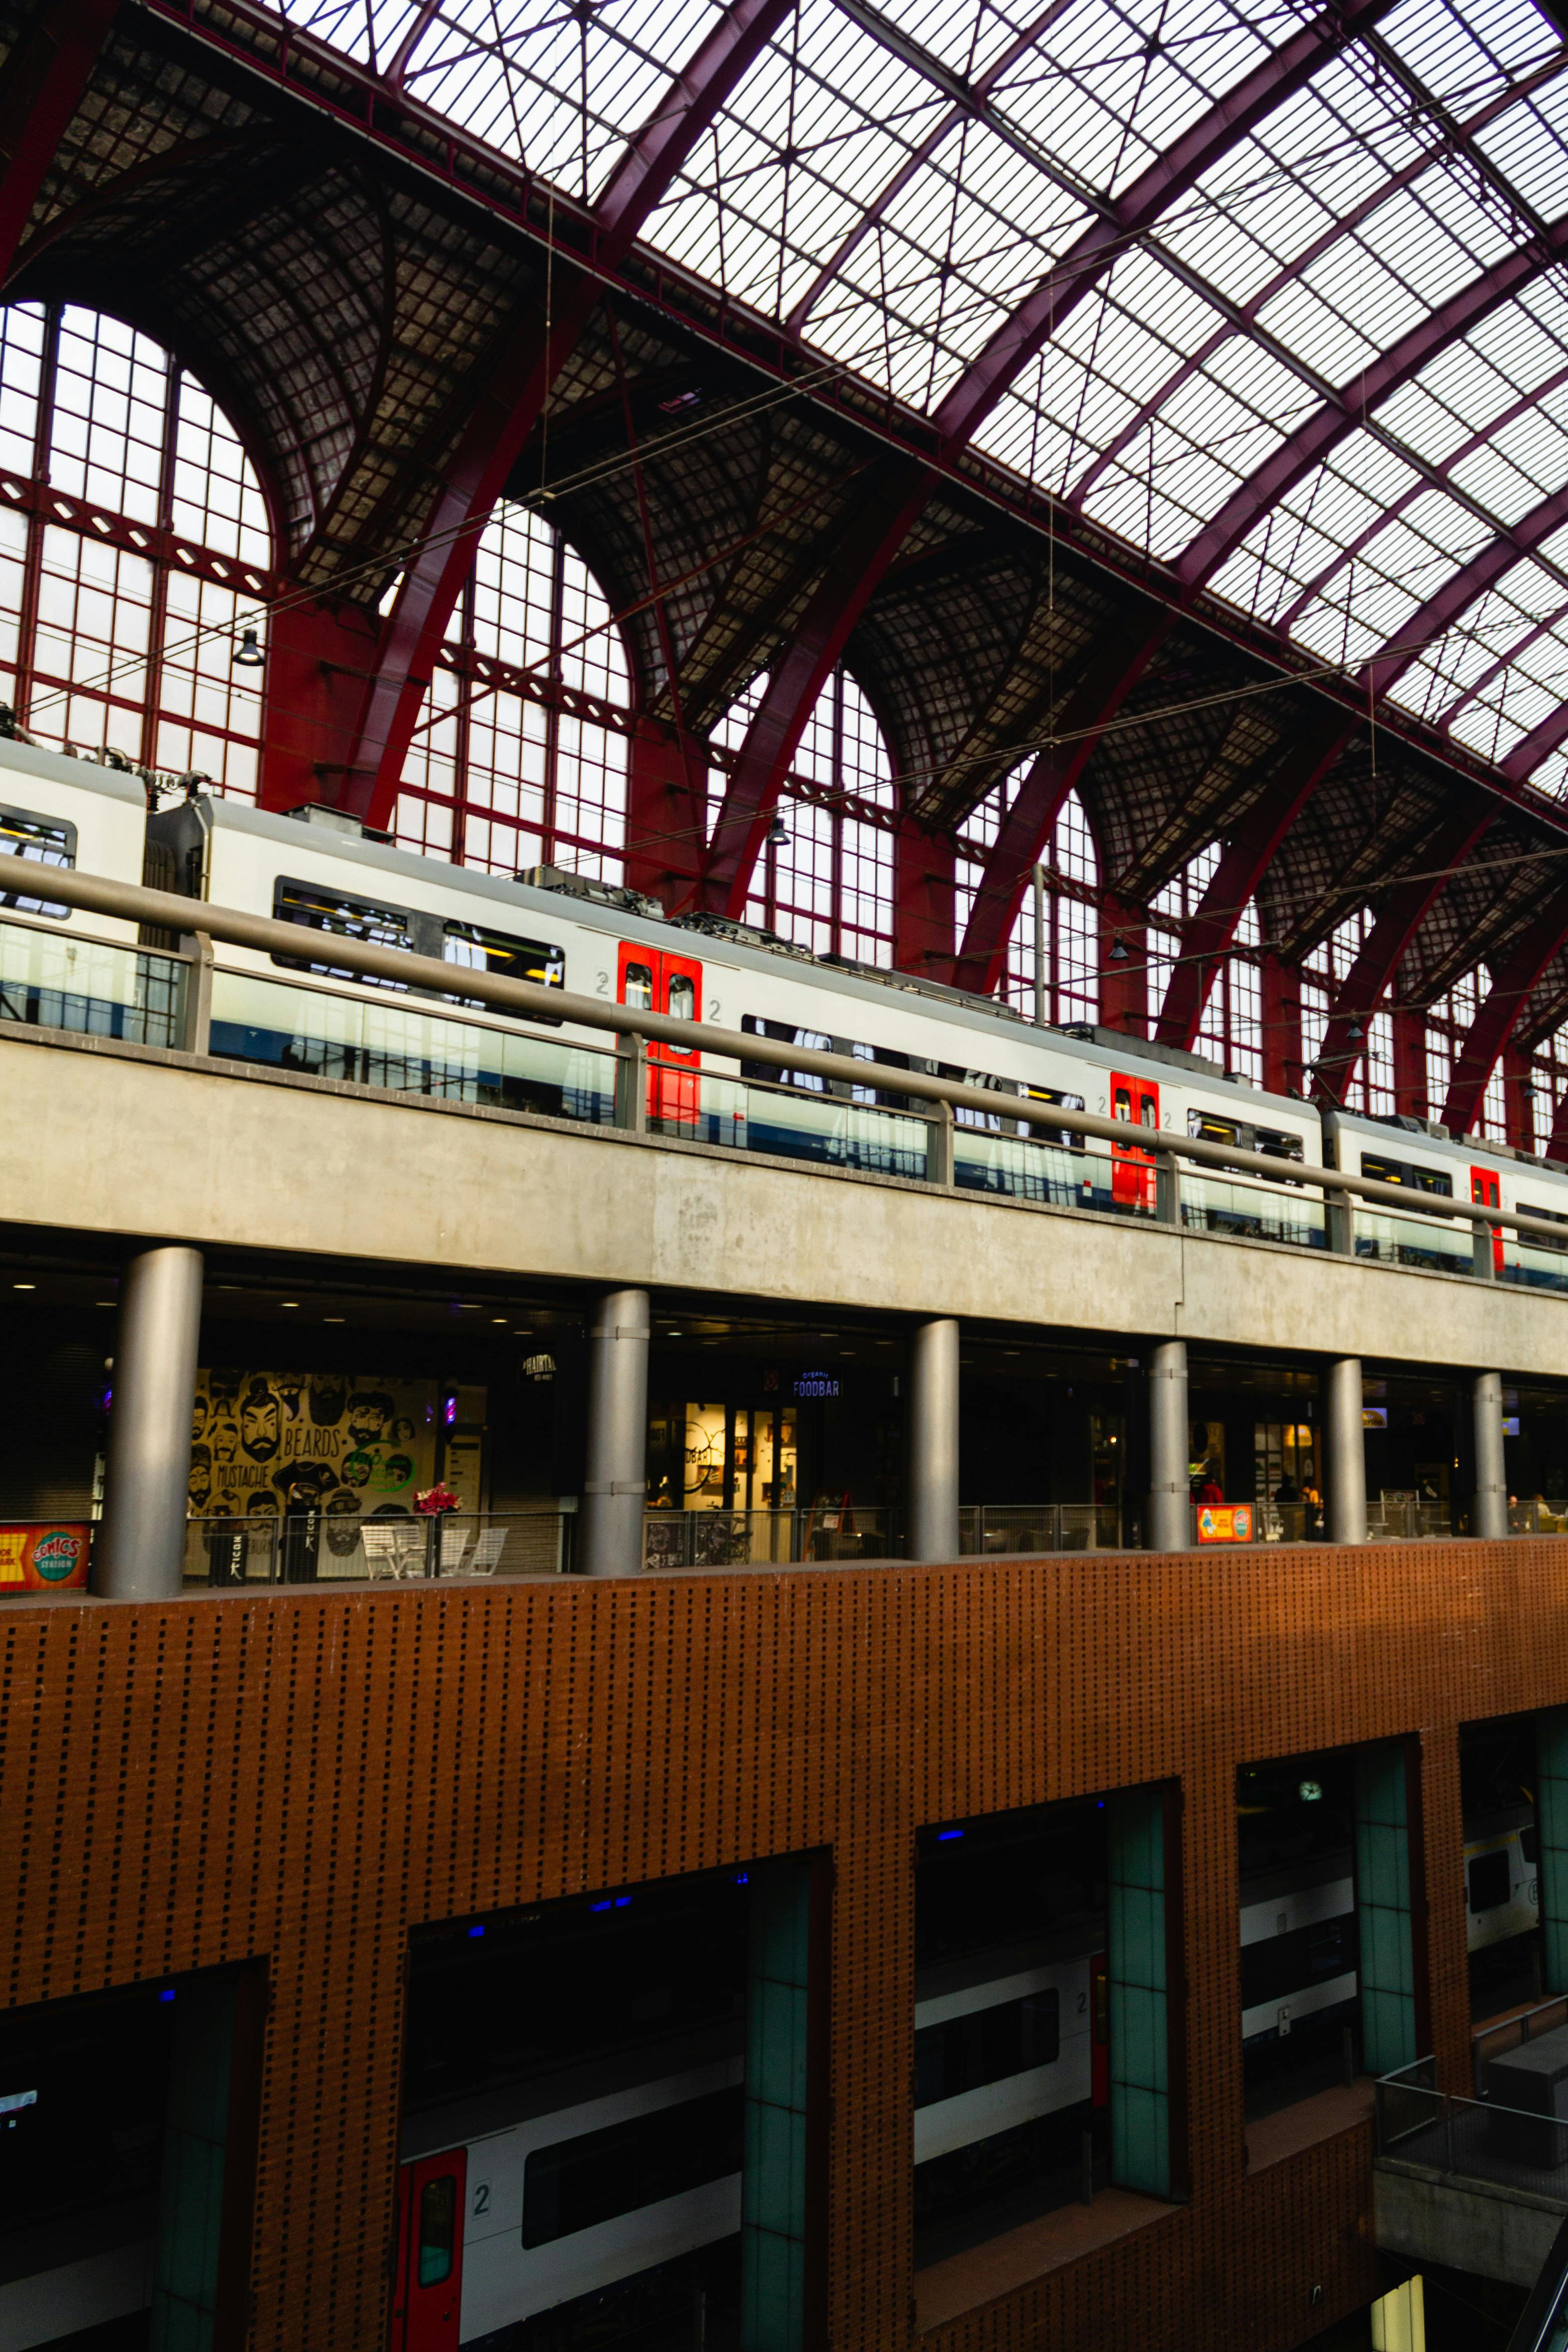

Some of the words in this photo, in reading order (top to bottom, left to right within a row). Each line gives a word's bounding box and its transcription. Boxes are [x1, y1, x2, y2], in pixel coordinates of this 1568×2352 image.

[597, 971, 609, 995] 2
[710, 1000, 721, 1022] 2
[1099, 1096, 1106, 1114] 2
[1165, 1112, 1172, 1129] 2
[1464, 1186, 1469, 1200] 2
[1503, 1195, 1508, 1208] 2
[794, 1381, 839, 1396] FOODBAR
[284, 1428, 340, 1457] BEARDS
[217, 1464, 268, 1489] MUSTACHE
[1078, 1992, 1087, 2014] 2
[474, 2184, 489, 2216] 2
